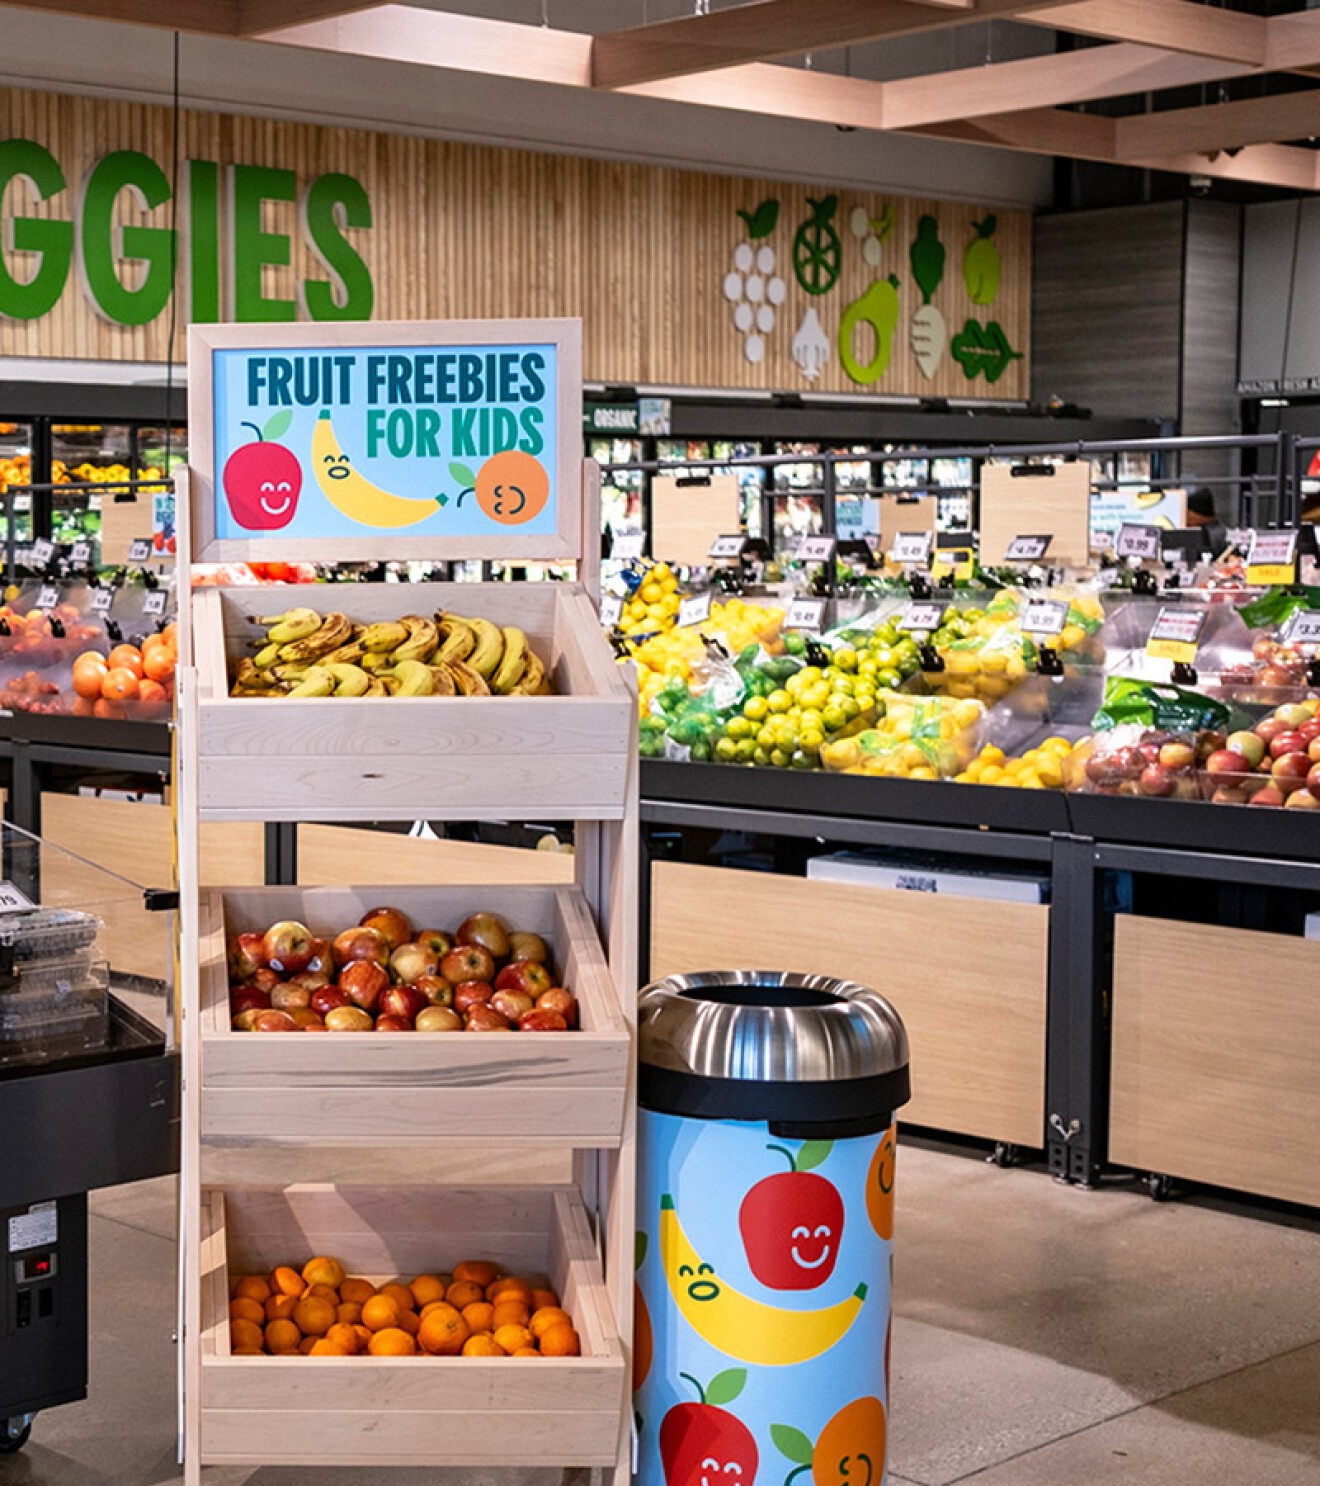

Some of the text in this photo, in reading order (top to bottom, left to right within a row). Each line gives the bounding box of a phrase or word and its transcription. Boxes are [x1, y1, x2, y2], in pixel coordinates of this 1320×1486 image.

[247, 352, 545, 407] FRUIT FREEBIES
[366, 406, 545, 459] FOR KIDS
[594, 408, 637, 428] ORGANIC
